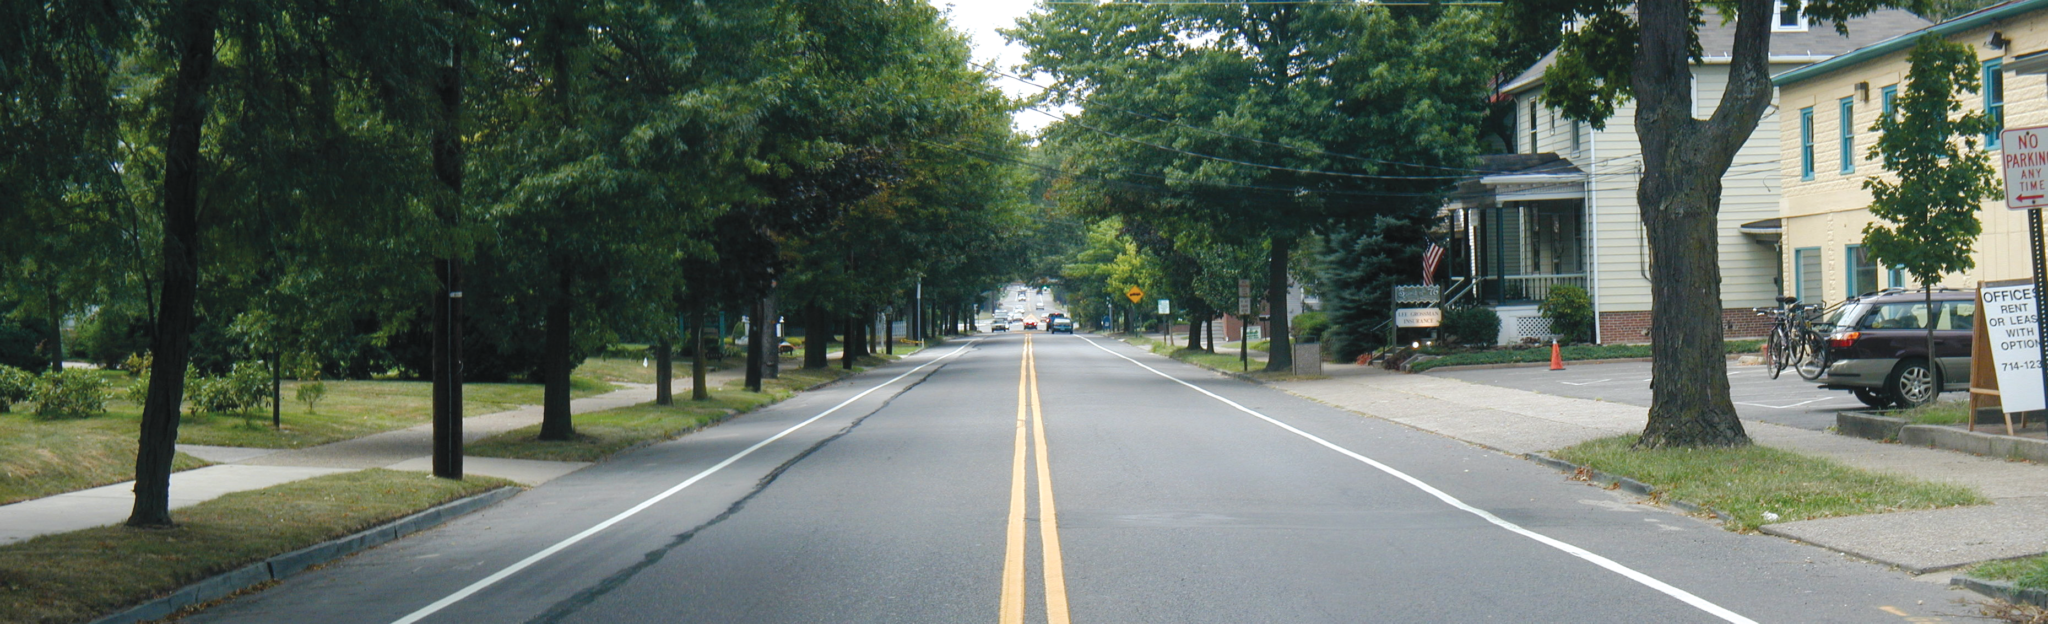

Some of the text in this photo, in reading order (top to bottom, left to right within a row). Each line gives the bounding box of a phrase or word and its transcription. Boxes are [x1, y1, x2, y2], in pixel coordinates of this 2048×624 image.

[2018, 134, 2038, 149] NO
[2006, 151, 2048, 168] PARKIN
[2021, 168, 2041, 179] ANY
[2019, 180, 2045, 191] TIME
[2001, 304, 2028, 313] RENT
[1989, 315, 2038, 327] OR LEAS
[2006, 328, 2034, 337] WITH
[2002, 361, 2042, 371] 714-123
